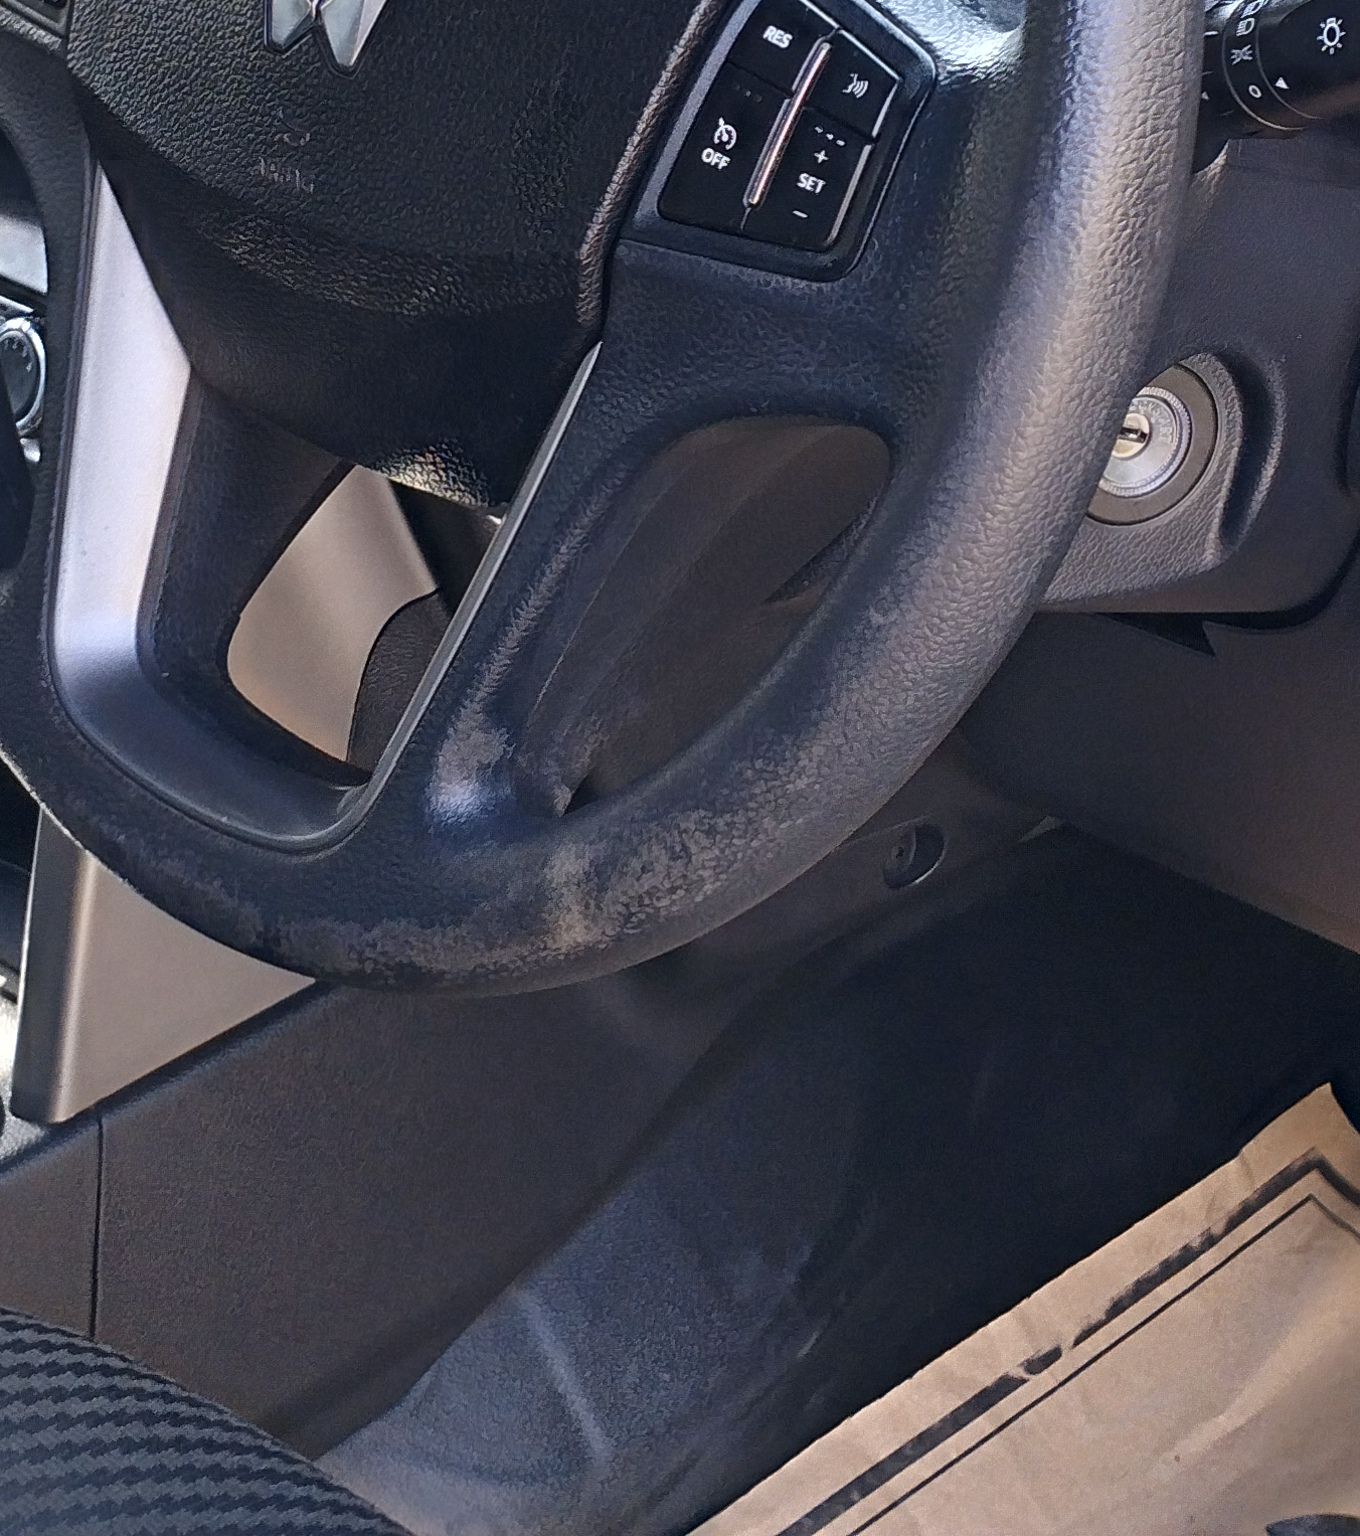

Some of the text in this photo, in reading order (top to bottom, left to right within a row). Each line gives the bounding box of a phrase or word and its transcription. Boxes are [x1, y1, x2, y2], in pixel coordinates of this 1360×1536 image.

[762, 25, 794, 50] RES
[700, 147, 732, 171] OFF
[796, 172, 827, 194] SET
